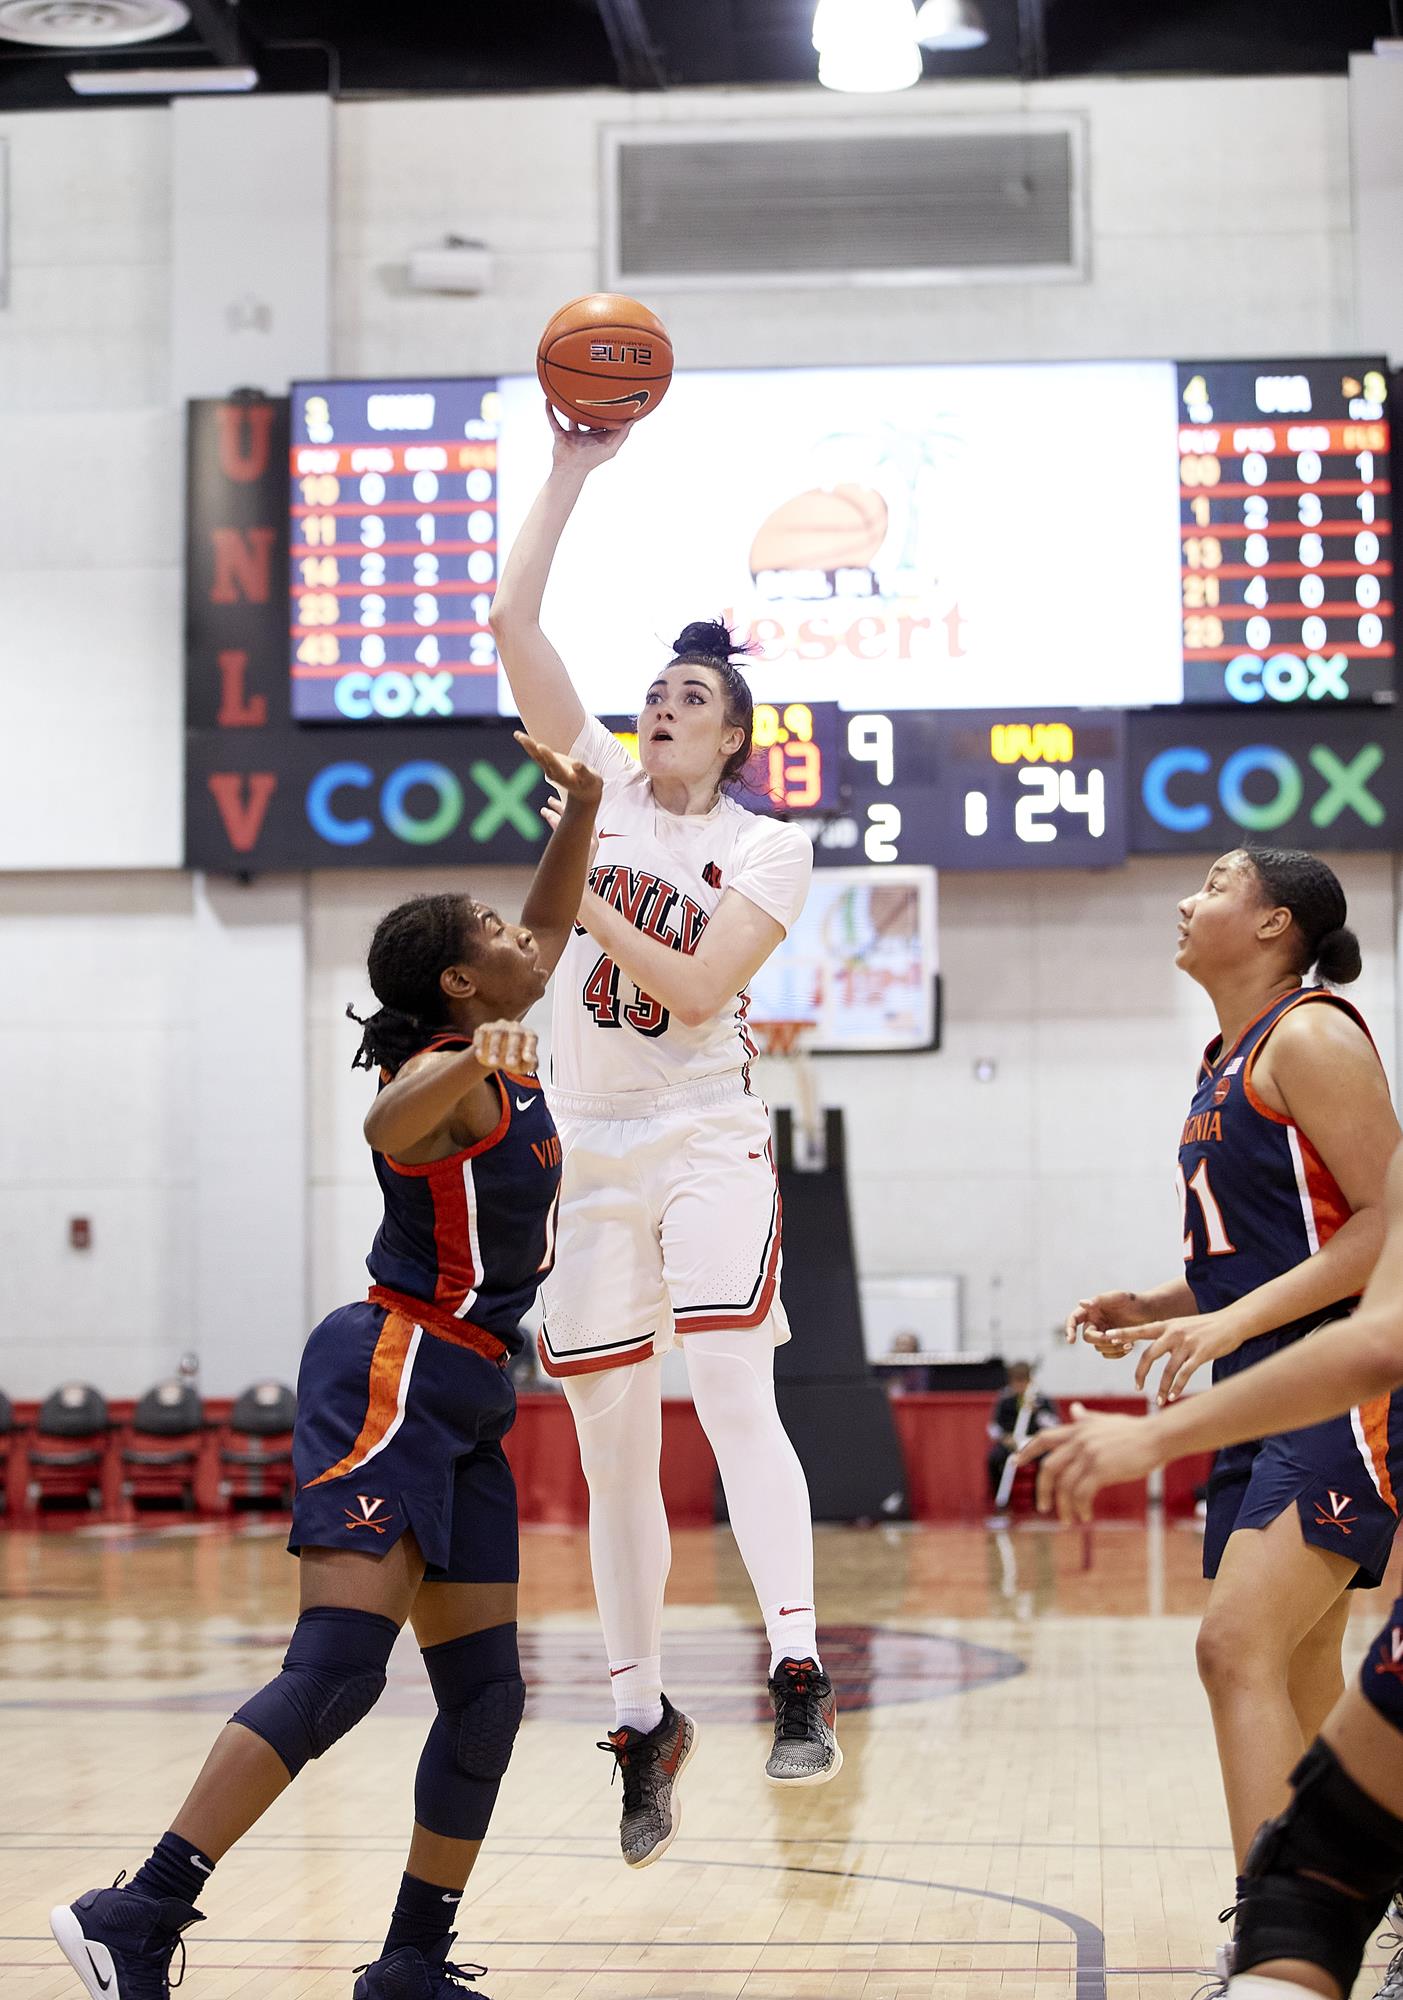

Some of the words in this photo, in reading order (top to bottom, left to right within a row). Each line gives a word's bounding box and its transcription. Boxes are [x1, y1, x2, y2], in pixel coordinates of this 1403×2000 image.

[590, 345, 652, 366] ELITE
[1243, 452, 1268, 487] 0
[1297, 450, 1322, 484] 0
[1356, 449, 1374, 484] 1
[1191, 495, 1211, 528] 1
[1244, 495, 1269, 530] 2
[1298, 492, 1323, 527] 3
[1356, 490, 1375, 525] 1
[360, 514, 386, 549] 3
[415, 512, 435, 546] 1
[467, 510, 494, 543] 0
[1355, 530, 1379, 565] 0
[360, 552, 386, 586] 2
[413, 552, 439, 586] 2
[467, 550, 494, 584] 0
[360, 593, 386, 628] 2
[413, 592, 439, 627] 3
[1244, 575, 1269, 609] 4
[1299, 574, 1325, 608] 0
[1356, 574, 1380, 608] 0
[414, 633, 440, 668] 4
[469, 632, 495, 666] 2
[722, 601, 968, 661] esert
[1246, 616, 1271, 650] 0
[1302, 616, 1327, 650] 0
[1358, 613, 1382, 648] 0
[334, 671, 454, 719] COX
[1224, 652, 1349, 704] COX
[848, 714, 894, 786] 9
[768, 741, 821, 807] 13
[1143, 744, 1385, 831] COX
[306, 761, 542, 845] COX
[1015, 766, 1105, 842] 24
[865, 803, 901, 862] 2
[1181, 1110, 1223, 1145] GINIA
[356, 1494, 385, 1521] V
[1328, 1489, 1353, 1518] V
